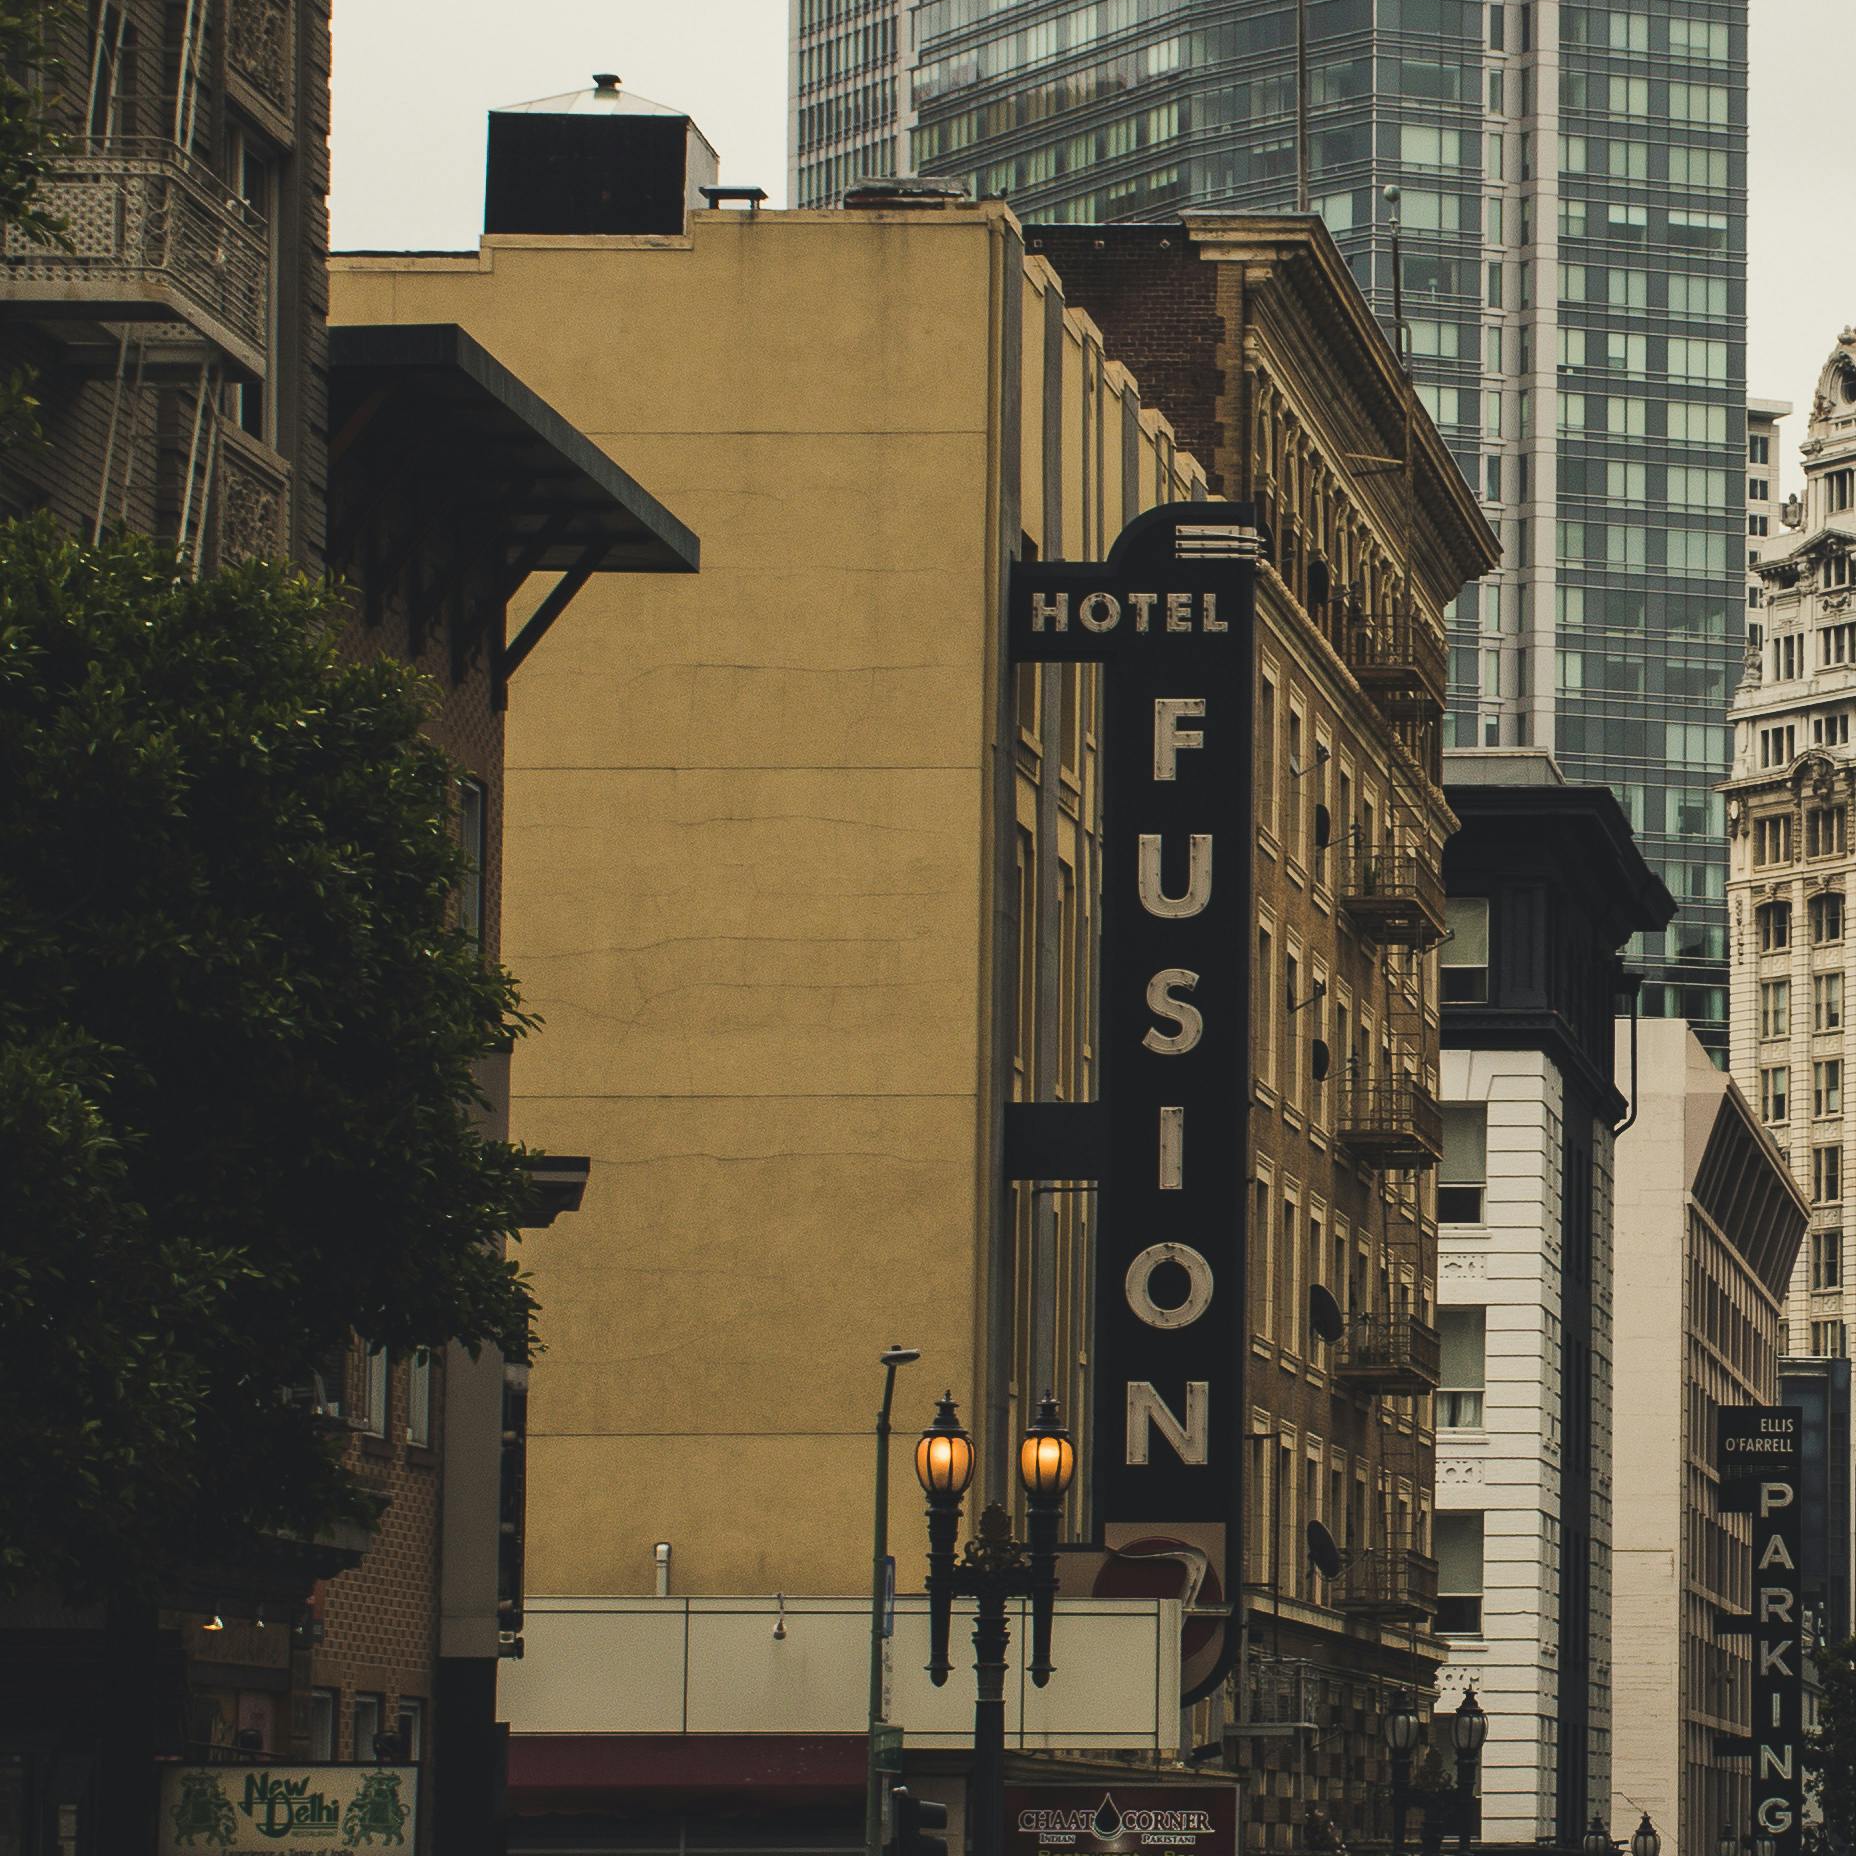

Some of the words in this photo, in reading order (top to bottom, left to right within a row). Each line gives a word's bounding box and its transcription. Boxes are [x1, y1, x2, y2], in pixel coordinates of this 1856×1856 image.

[1030, 592, 1229, 633] HOTEL
[1124, 697, 1213, 1466] FUSION
[1725, 1437, 1793, 1452] O'FARRELL
[1760, 1418, 1794, 1433] ELLIS
[1758, 1482, 1796, 1835] PARKING
[238, 1771, 310, 1817] New
[255, 1792, 340, 1838] Delhi
[1018, 1809, 1096, 1830] CHAAT
[1121, 1809, 1212, 1830] CORNER
